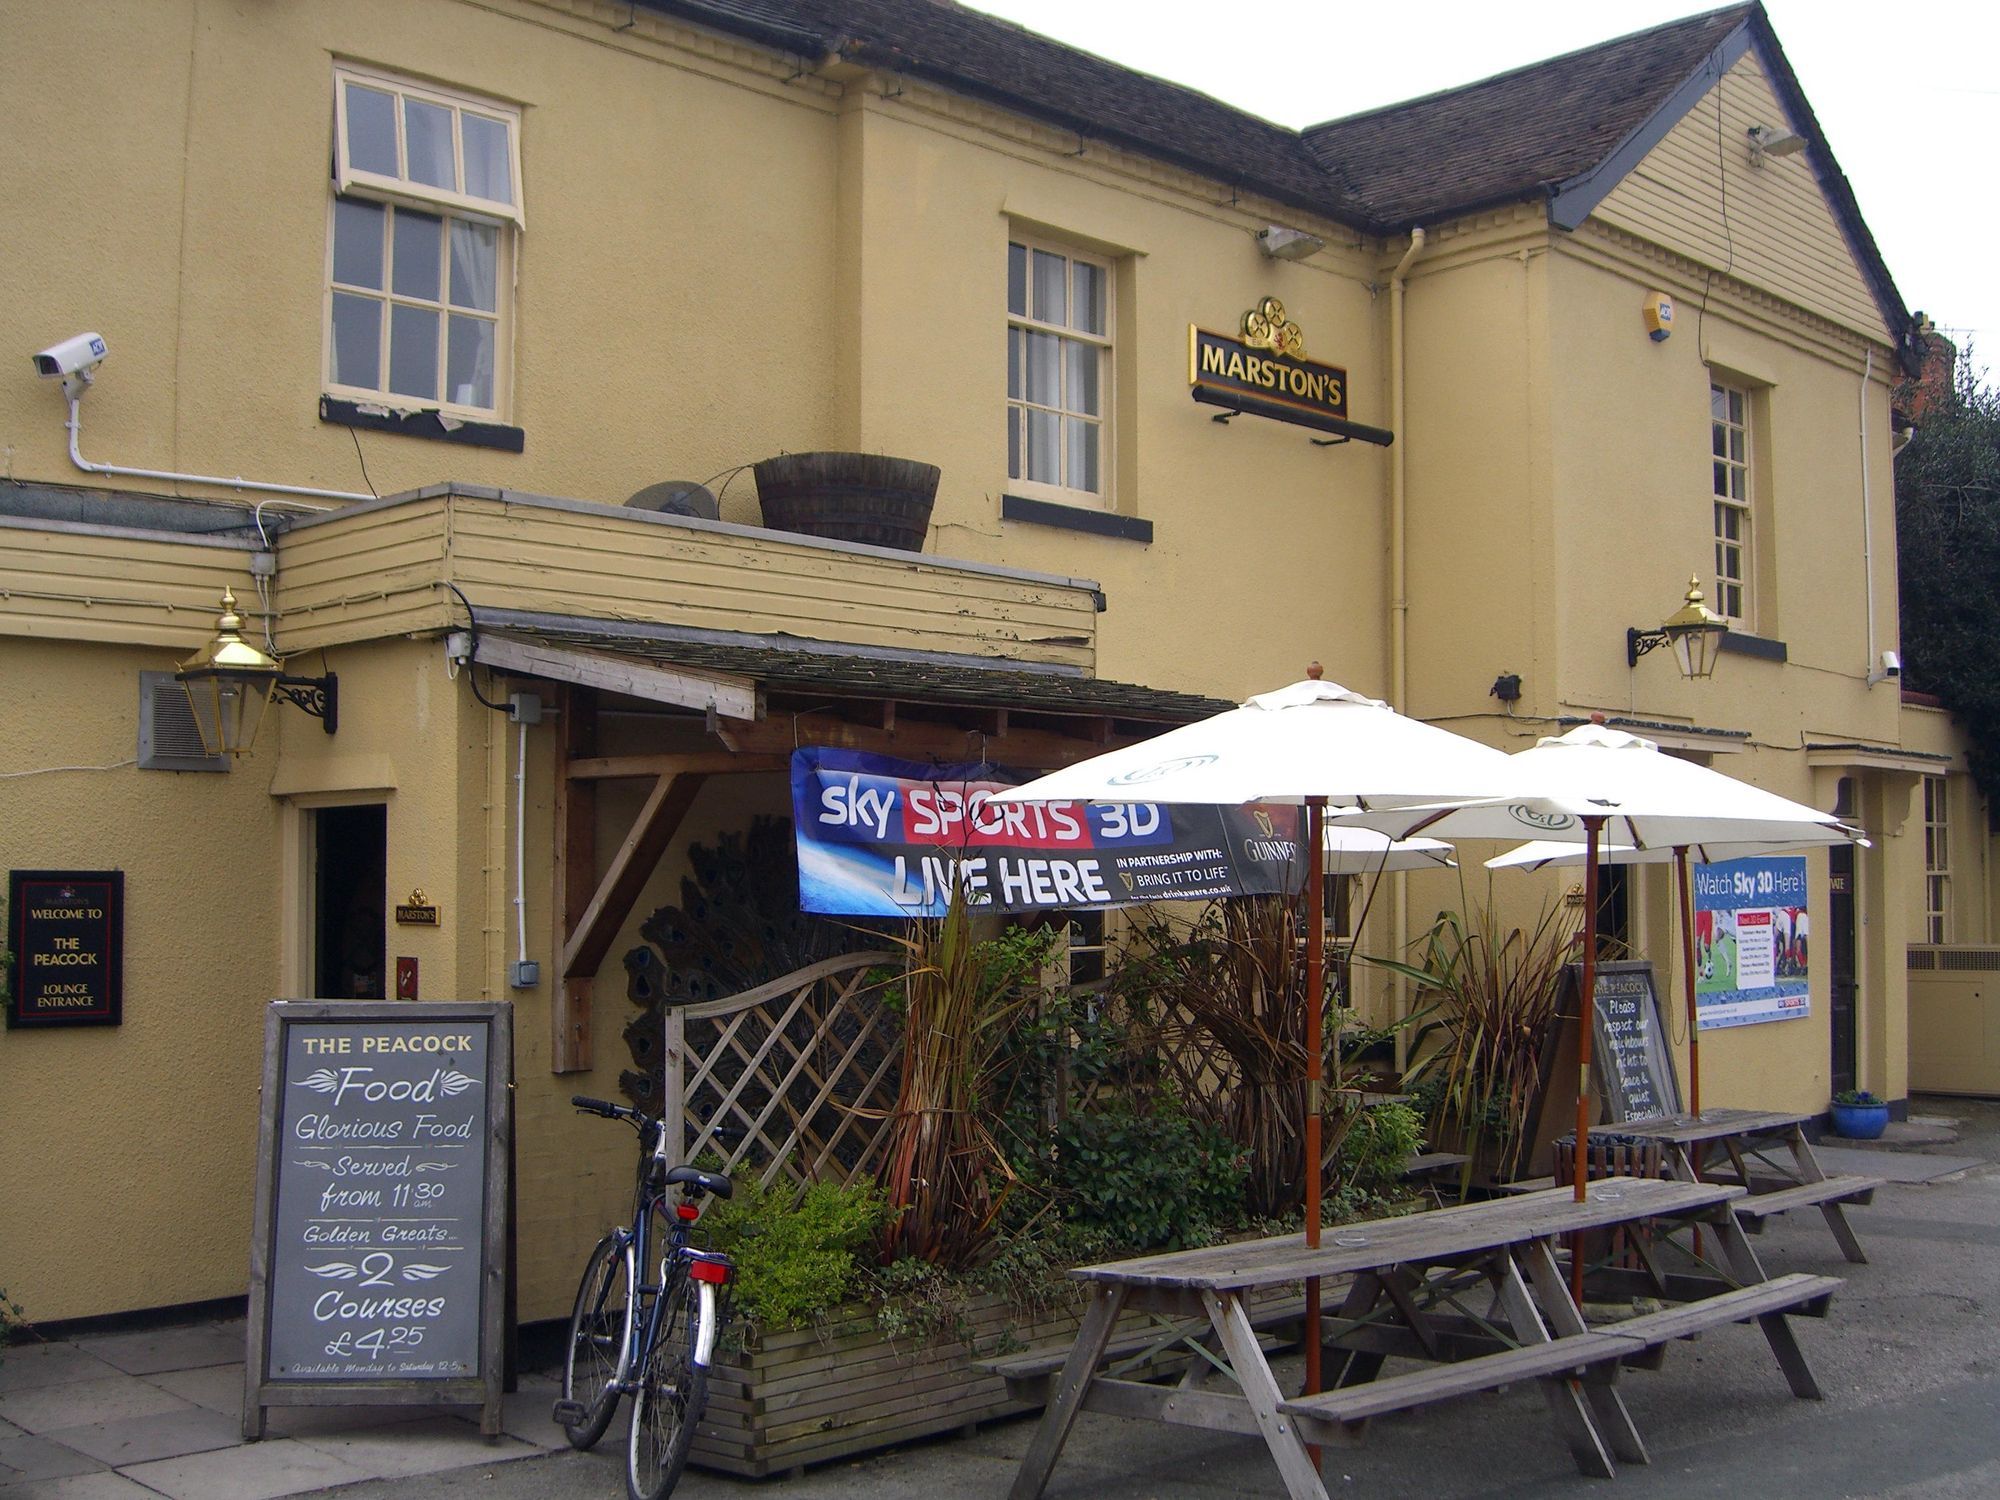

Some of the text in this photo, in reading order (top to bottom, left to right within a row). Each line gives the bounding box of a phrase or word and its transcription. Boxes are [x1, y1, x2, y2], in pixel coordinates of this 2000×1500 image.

[1202, 343, 1342, 406] MARSTON'S
[819, 776, 1160, 840] sky SPORTS 3D
[1116, 848, 1223, 869] IN PARTNERSHIP WITH:
[1244, 838, 1297, 864] GUINNES
[893, 856, 1112, 906] LIVE HERE
[1137, 872, 1171, 887] BRING
[1172, 871, 1182, 884] IT
[1185, 869, 1202, 882] TO
[1696, 873, 1732, 895] Watch
[1734, 871, 1756, 899] Sky
[1757, 871, 1773, 893] 3D
[1163, 884, 1232, 899] drinkaware.co.uk
[31, 908, 103, 919] WELCOME TO
[54, 937, 80, 950] THE
[34, 952, 98, 966] PEACOCK
[43, 983, 88, 995] LOUNGE
[37, 995, 94, 1007] ENTRANCE
[1609, 1000, 1636, 1014] Please
[1604, 1018, 1633, 1037] respect
[303, 1035, 472, 1055] THE PEACOCK
[334, 1067, 440, 1106] Food
[1628, 1089, 1651, 1110] quiet
[1624, 1105, 1664, 1123] Especially
[295, 1113, 475, 1140] Glorious Food
[332, 1154, 413, 1177] Served
[321, 1183, 382, 1212] from
[303, 1225, 371, 1243] Golden
[358, 1251, 395, 1287] 2
[313, 1290, 446, 1322] Courses
[324, 1326, 427, 1360] £4.25
[291, 1362, 340, 1374] Available
[344, 1362, 385, 1375] Monday
[387, 1363, 396, 1373] to
[399, 1361, 435, 1374] Saturday
